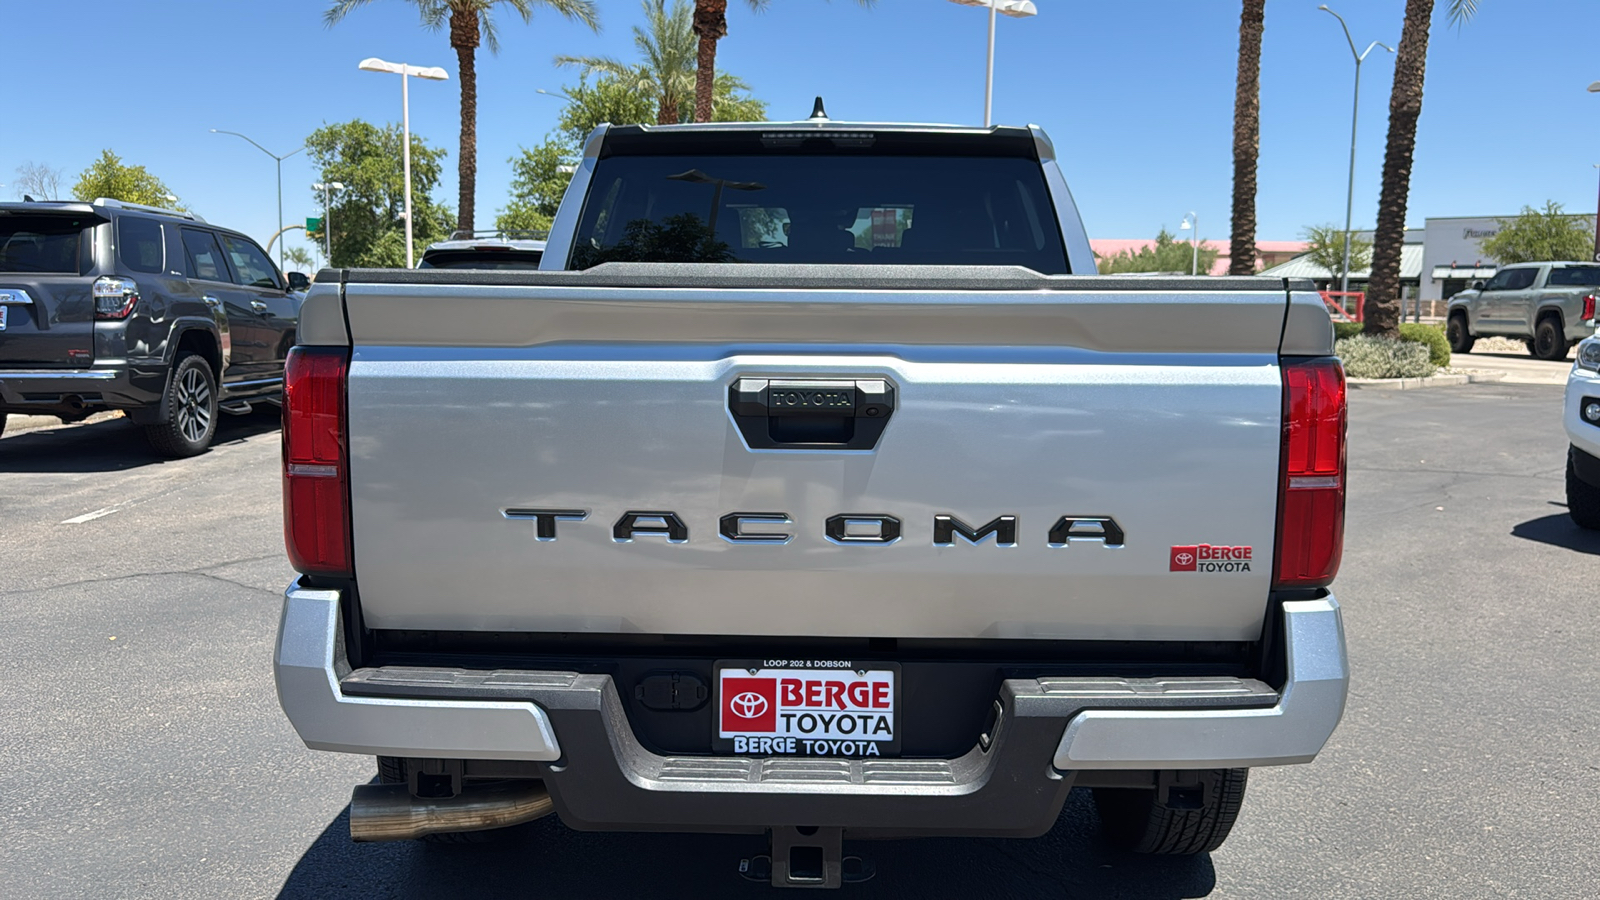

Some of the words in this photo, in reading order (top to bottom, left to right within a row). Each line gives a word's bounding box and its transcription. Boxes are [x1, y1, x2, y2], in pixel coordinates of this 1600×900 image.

[773, 391, 851, 406] TOYOTA
[501, 507, 1127, 549] TACOMA
[1198, 543, 1252, 560] BERGE
[1198, 562, 1251, 572] TOYOTA
[763, 659, 788, 667] LOOP
[814, 660, 851, 668] DOBSON
[780, 678, 890, 710] BERGE
[780, 713, 892, 735] TOYOTA
[734, 736, 796, 754] BERGE
[803, 740, 880, 756] TOYOTA
